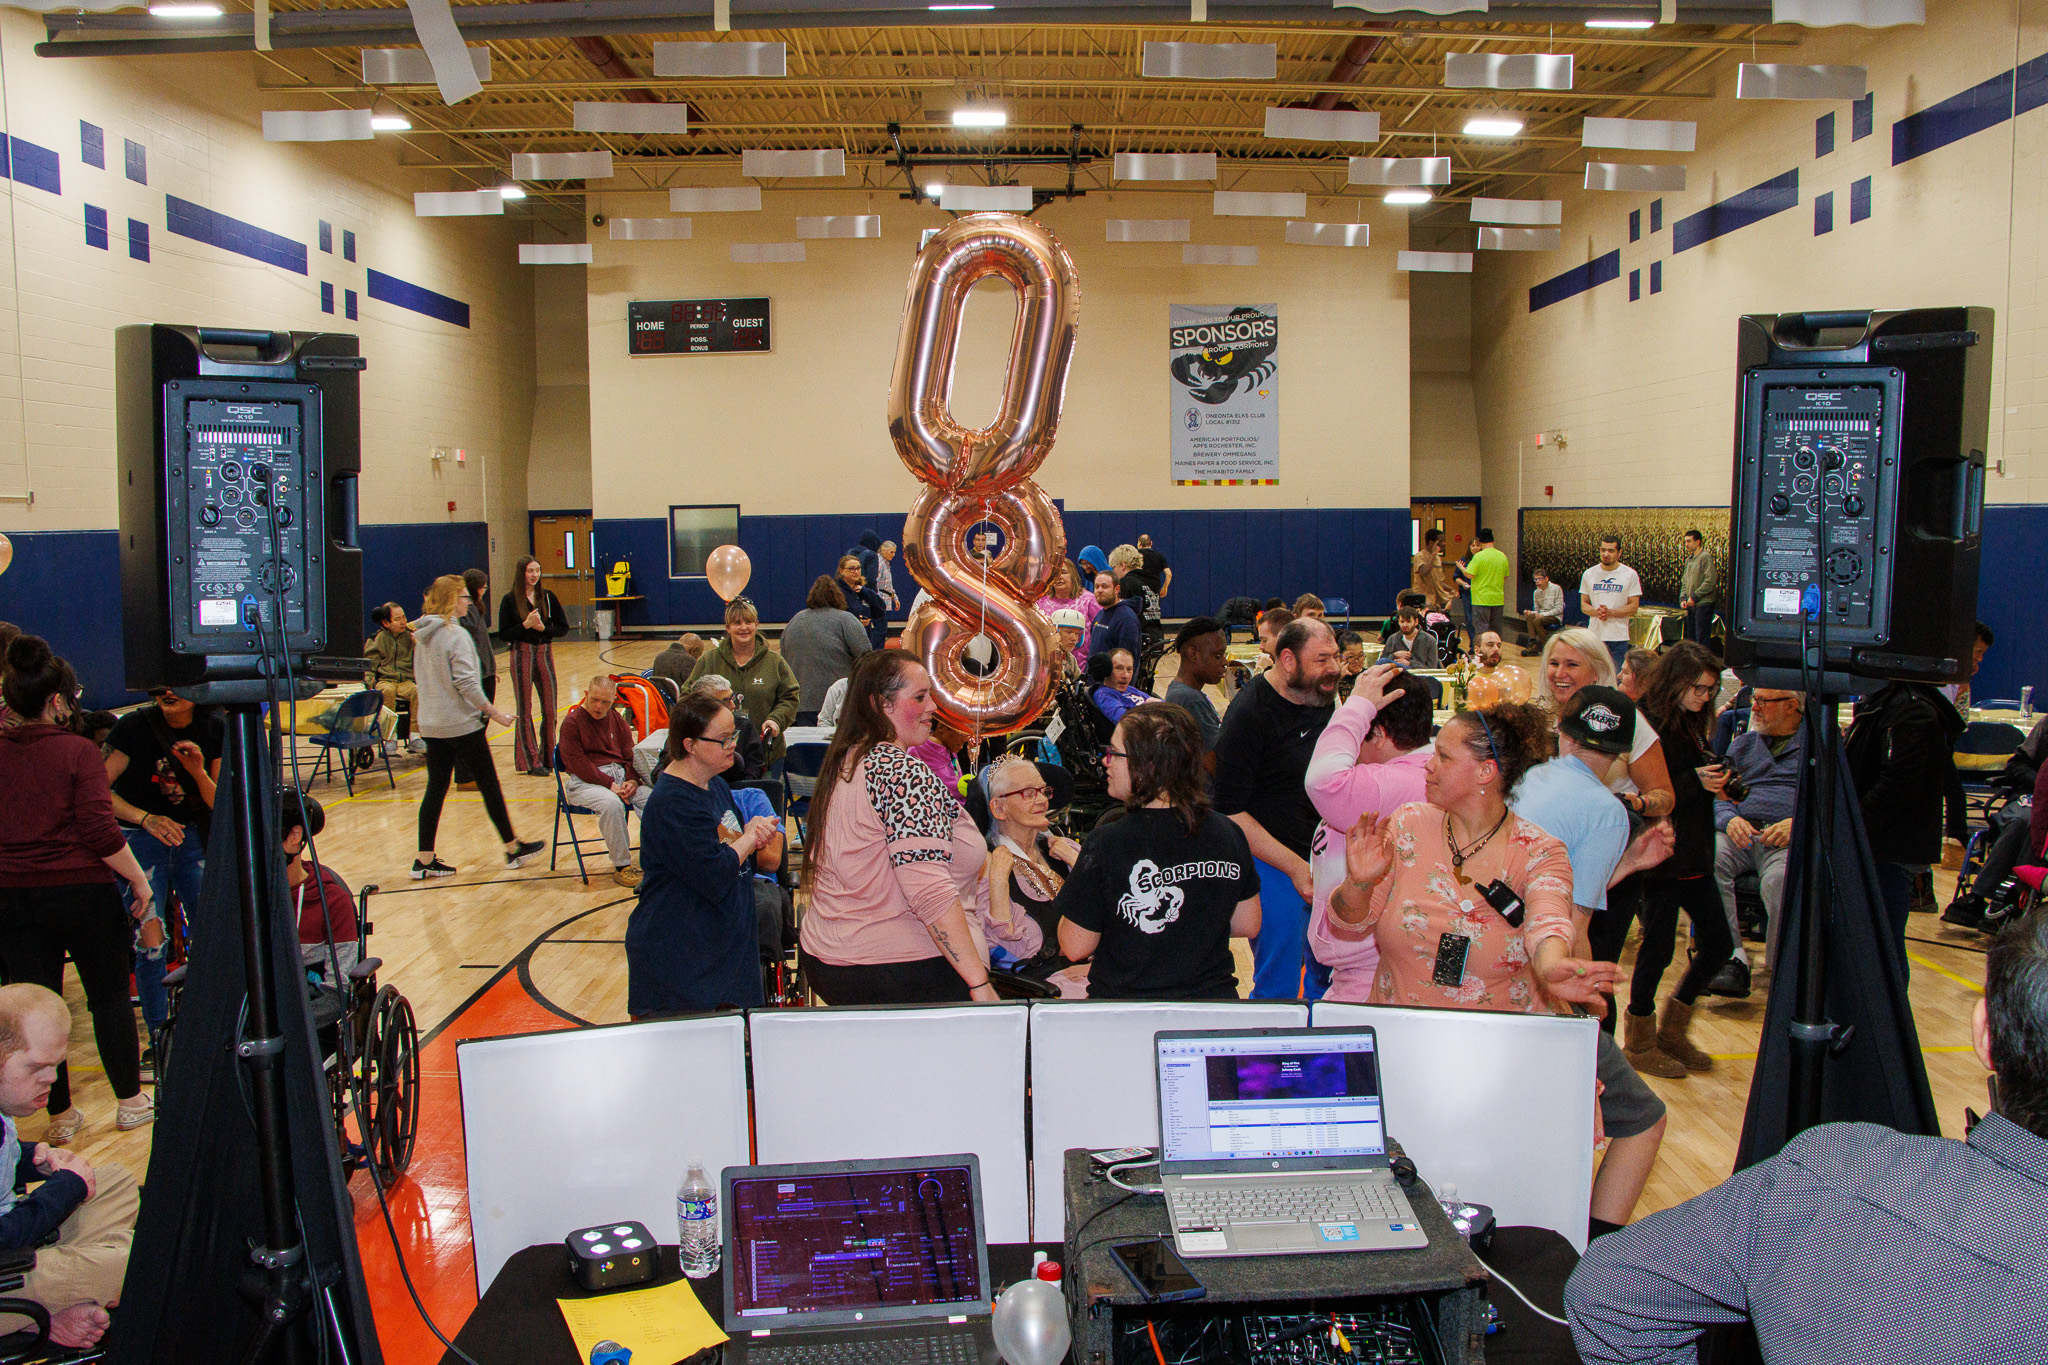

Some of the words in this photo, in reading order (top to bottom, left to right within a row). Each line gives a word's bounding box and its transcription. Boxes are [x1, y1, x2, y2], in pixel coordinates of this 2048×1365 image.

[732, 318, 764, 328] GUEST
[1173, 319, 1197, 327] THANK
[1241, 311, 1265, 320] PROUD
[636, 321, 665, 331] HOME
[1172, 319, 1277, 347] SPONSORS
[1230, 341, 1269, 350] SCORPIONS
[1804, 393, 1841, 401] QSC
[226, 406, 263, 415] QSC
[1592, 583, 1624, 593] HOLLISTER
[1136, 860, 1241, 893] SCORPIONS
